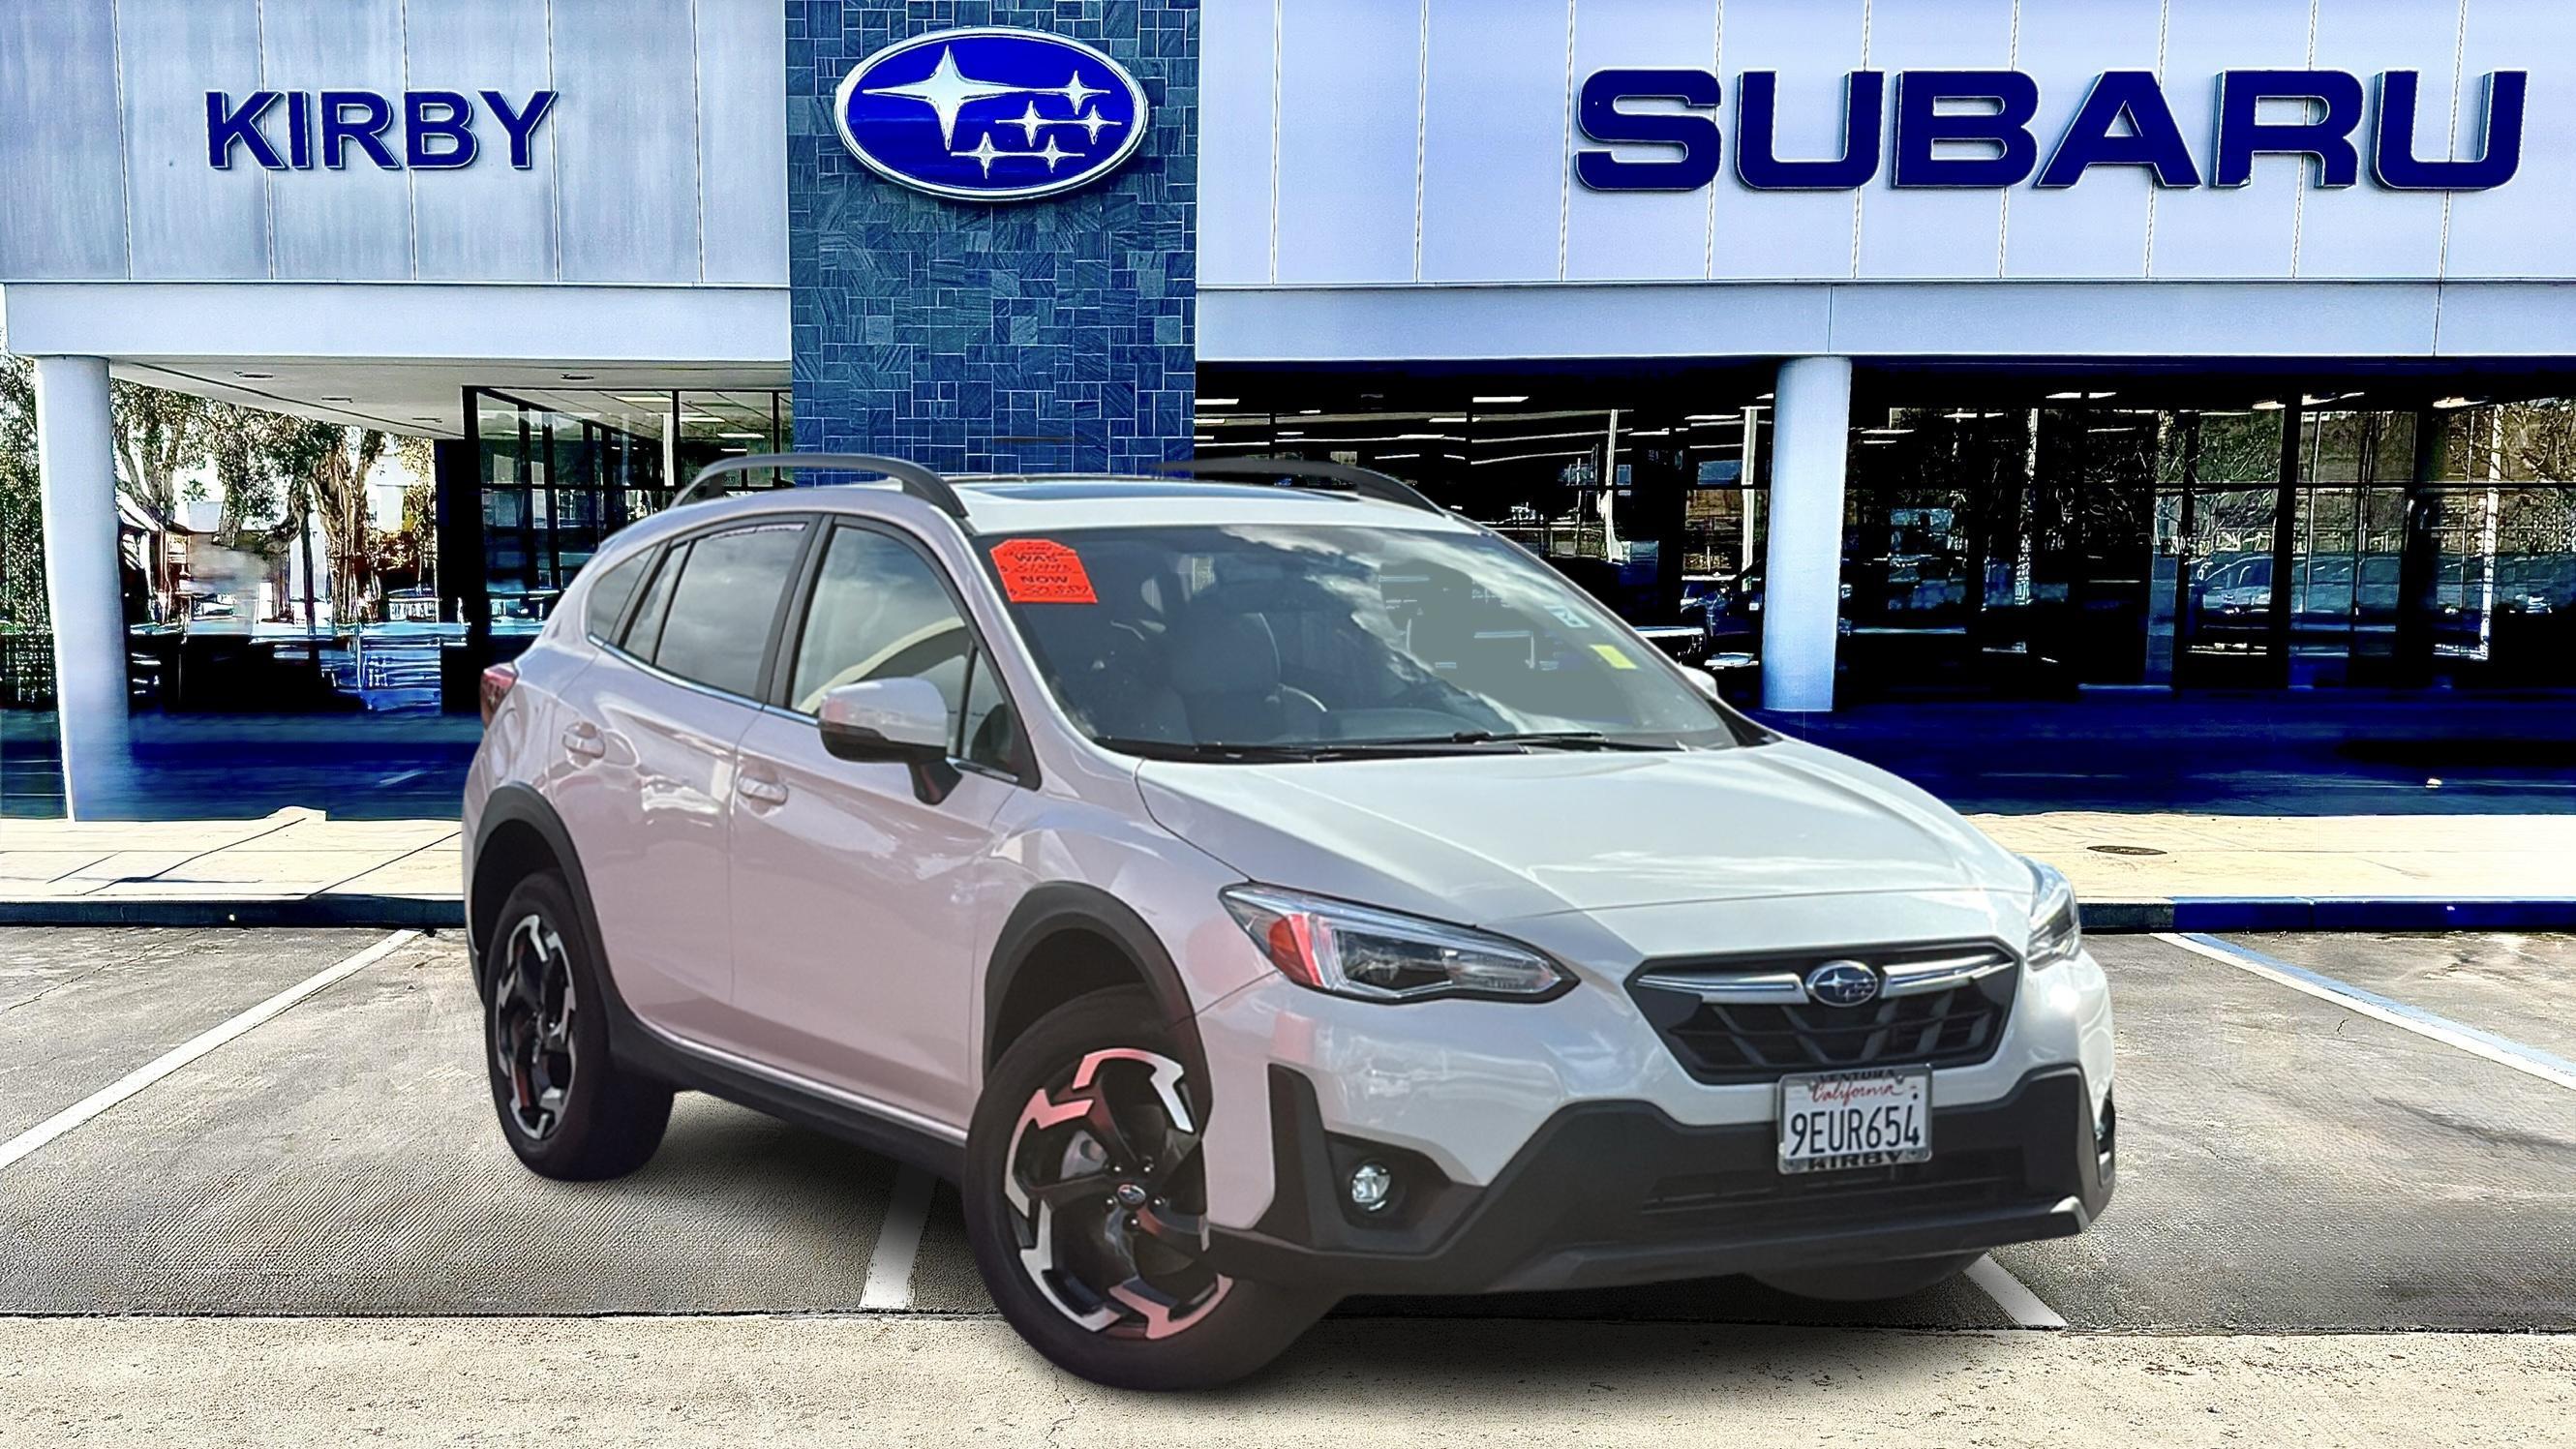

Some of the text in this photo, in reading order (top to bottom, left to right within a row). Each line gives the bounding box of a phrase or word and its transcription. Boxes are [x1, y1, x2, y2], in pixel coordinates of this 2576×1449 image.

[204, 89, 559, 170] KIRBY
[1574, 68, 2528, 191] SUBARU
[1015, 554, 1058, 563] WAS
[1019, 575, 1068, 584] NOW
[1819, 1069, 1895, 1082] VENTURA
[1811, 1082, 1903, 1106] California
[1791, 1104, 1920, 1156] 9EUR654
[1808, 1149, 1902, 1170] KIRBY
